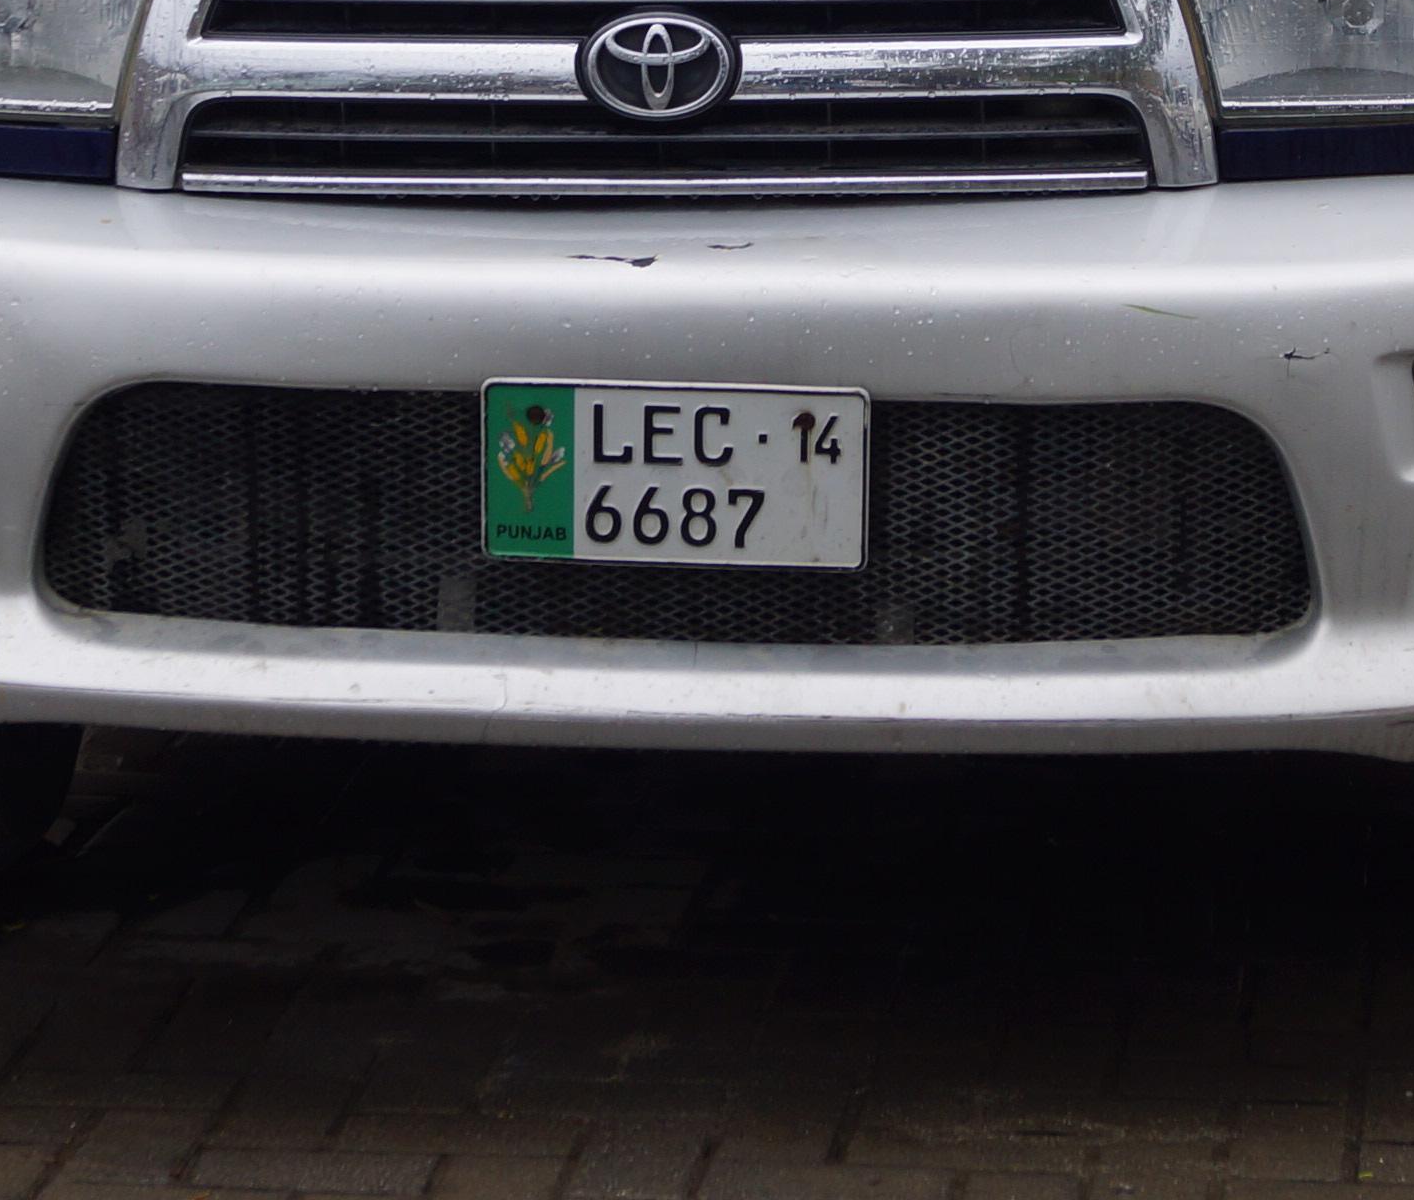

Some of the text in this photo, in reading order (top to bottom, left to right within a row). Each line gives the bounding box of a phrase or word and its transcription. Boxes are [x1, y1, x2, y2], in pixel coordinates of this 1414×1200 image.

[592, 402, 734, 467] LEC
[791, 411, 842, 465] 14
[496, 523, 567, 541] PUNJAB
[585, 484, 766, 549] 6687
